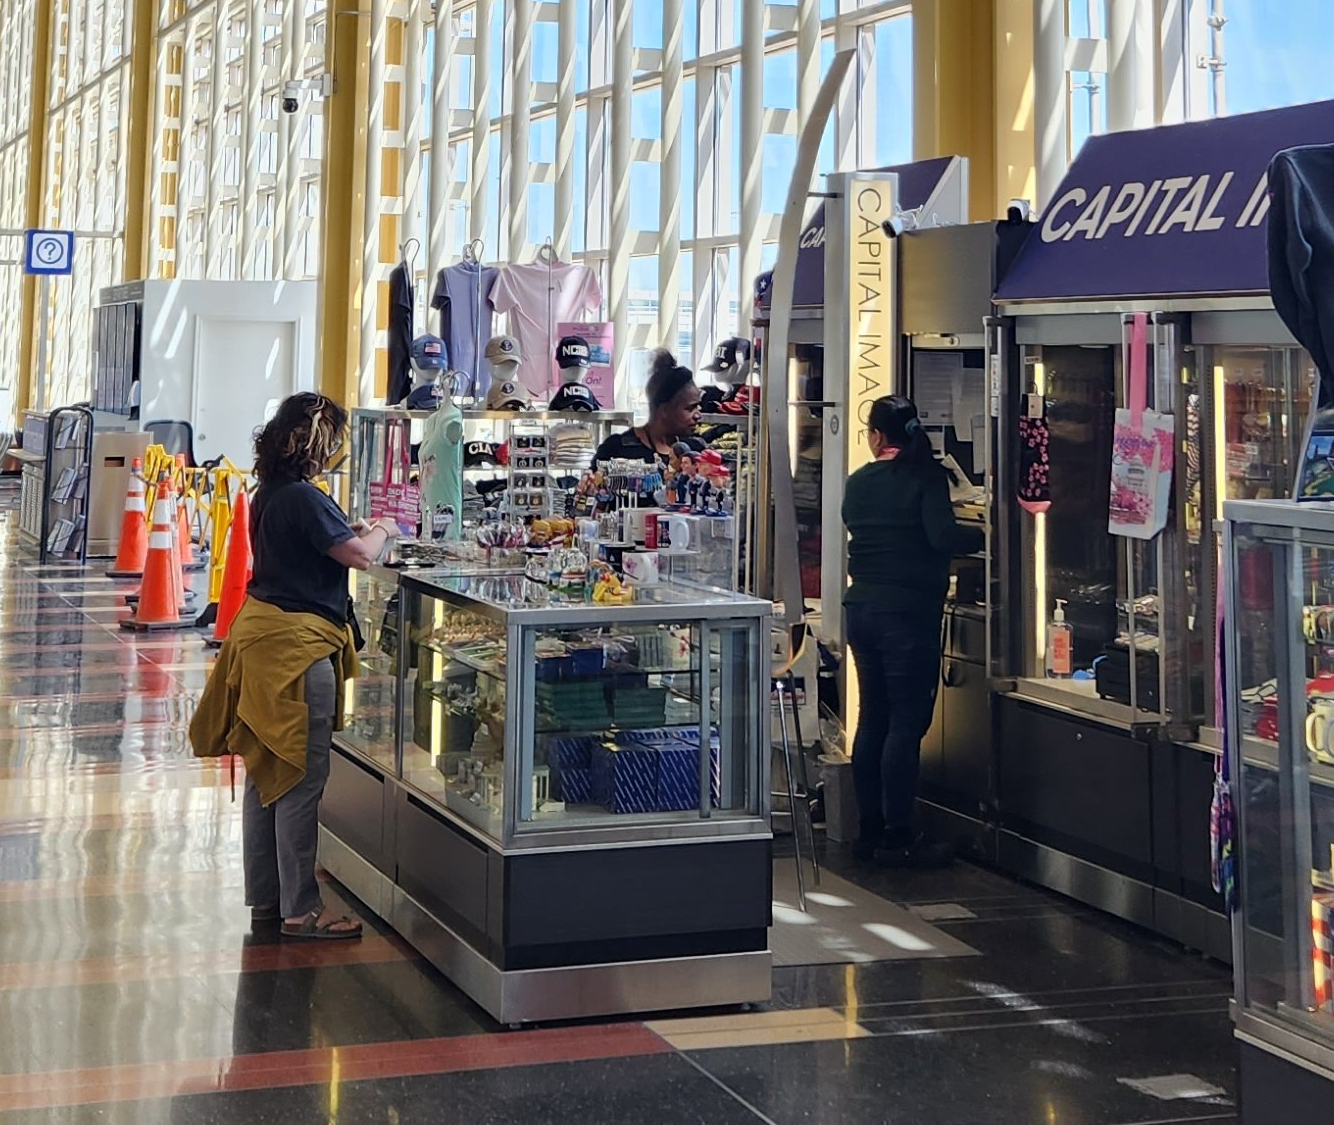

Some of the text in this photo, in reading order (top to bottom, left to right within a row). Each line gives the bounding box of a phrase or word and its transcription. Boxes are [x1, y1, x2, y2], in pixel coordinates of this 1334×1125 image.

[1041, 172, 1234, 243] CAPITAL
[857, 187, 882, 322] CAPITAL
[468, 442, 493, 456] CIA
